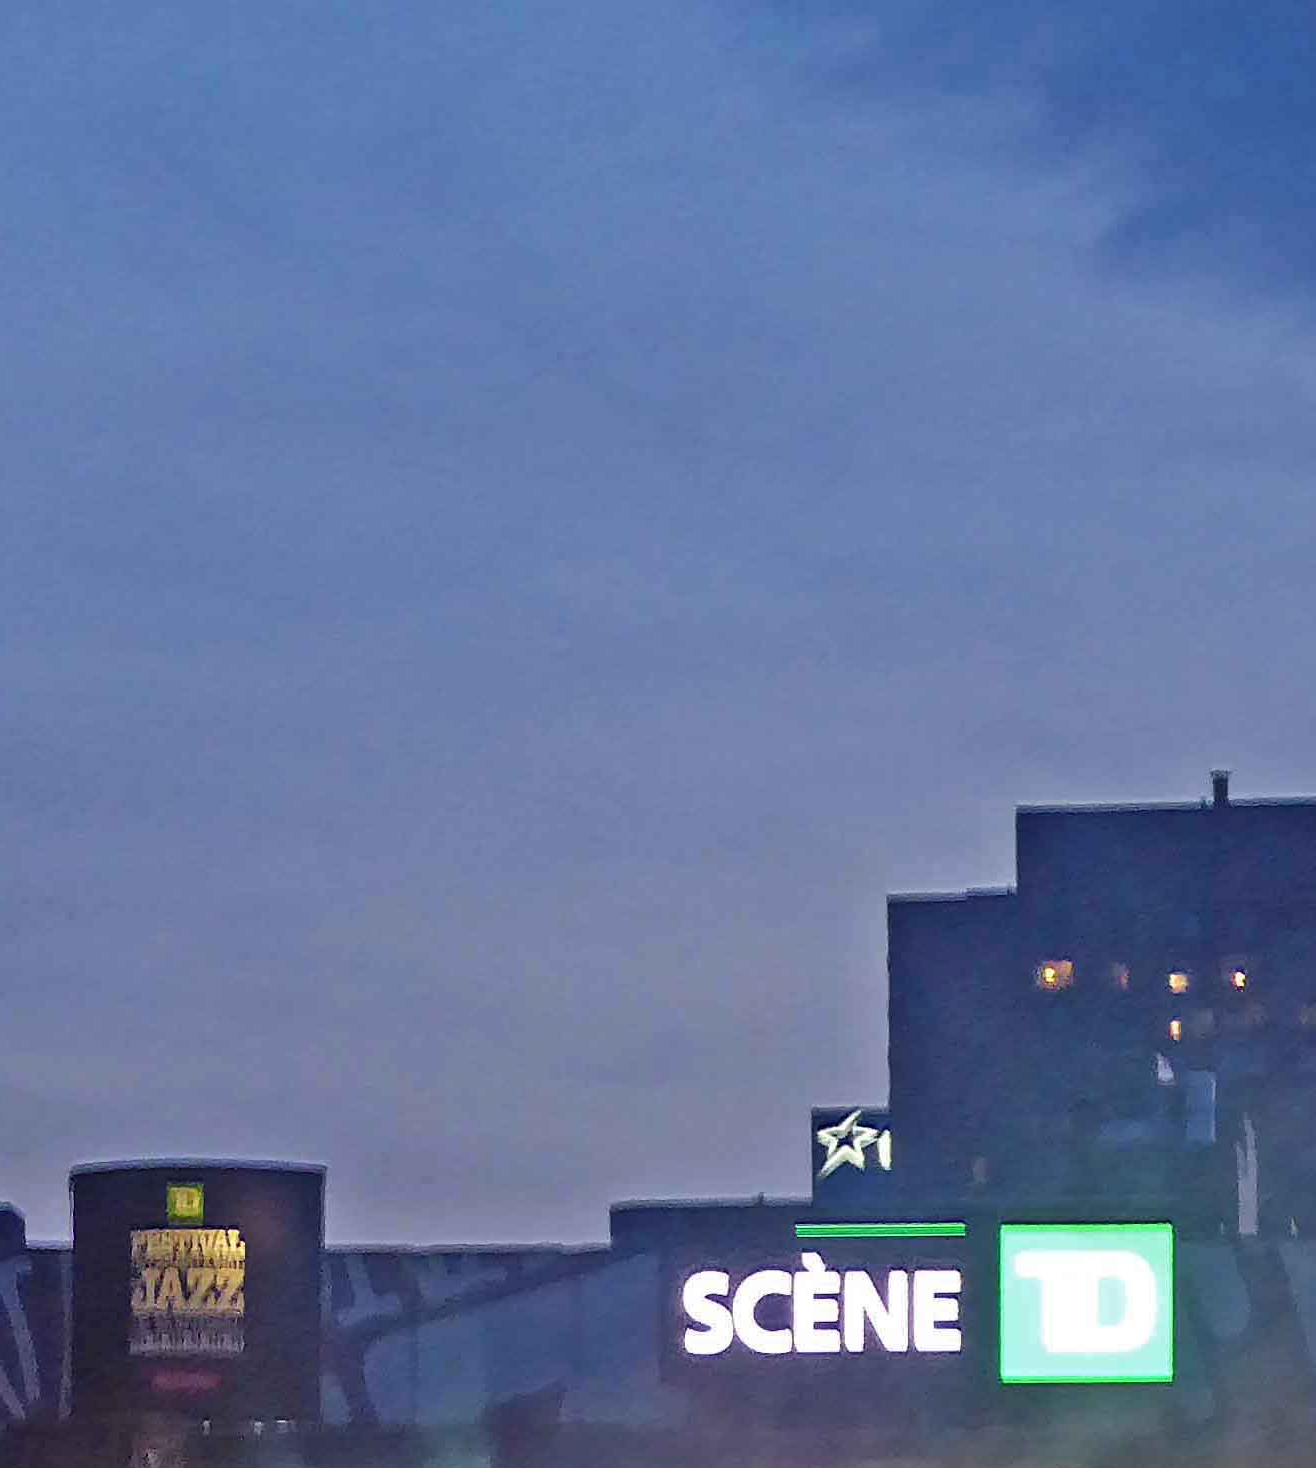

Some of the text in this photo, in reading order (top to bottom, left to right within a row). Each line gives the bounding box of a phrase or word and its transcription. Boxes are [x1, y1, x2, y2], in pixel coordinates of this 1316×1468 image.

[131, 1267, 245, 1315] JAZZ
[685, 1253, 962, 1355] SCÈNE
[1015, 1250, 1157, 1353] TD
